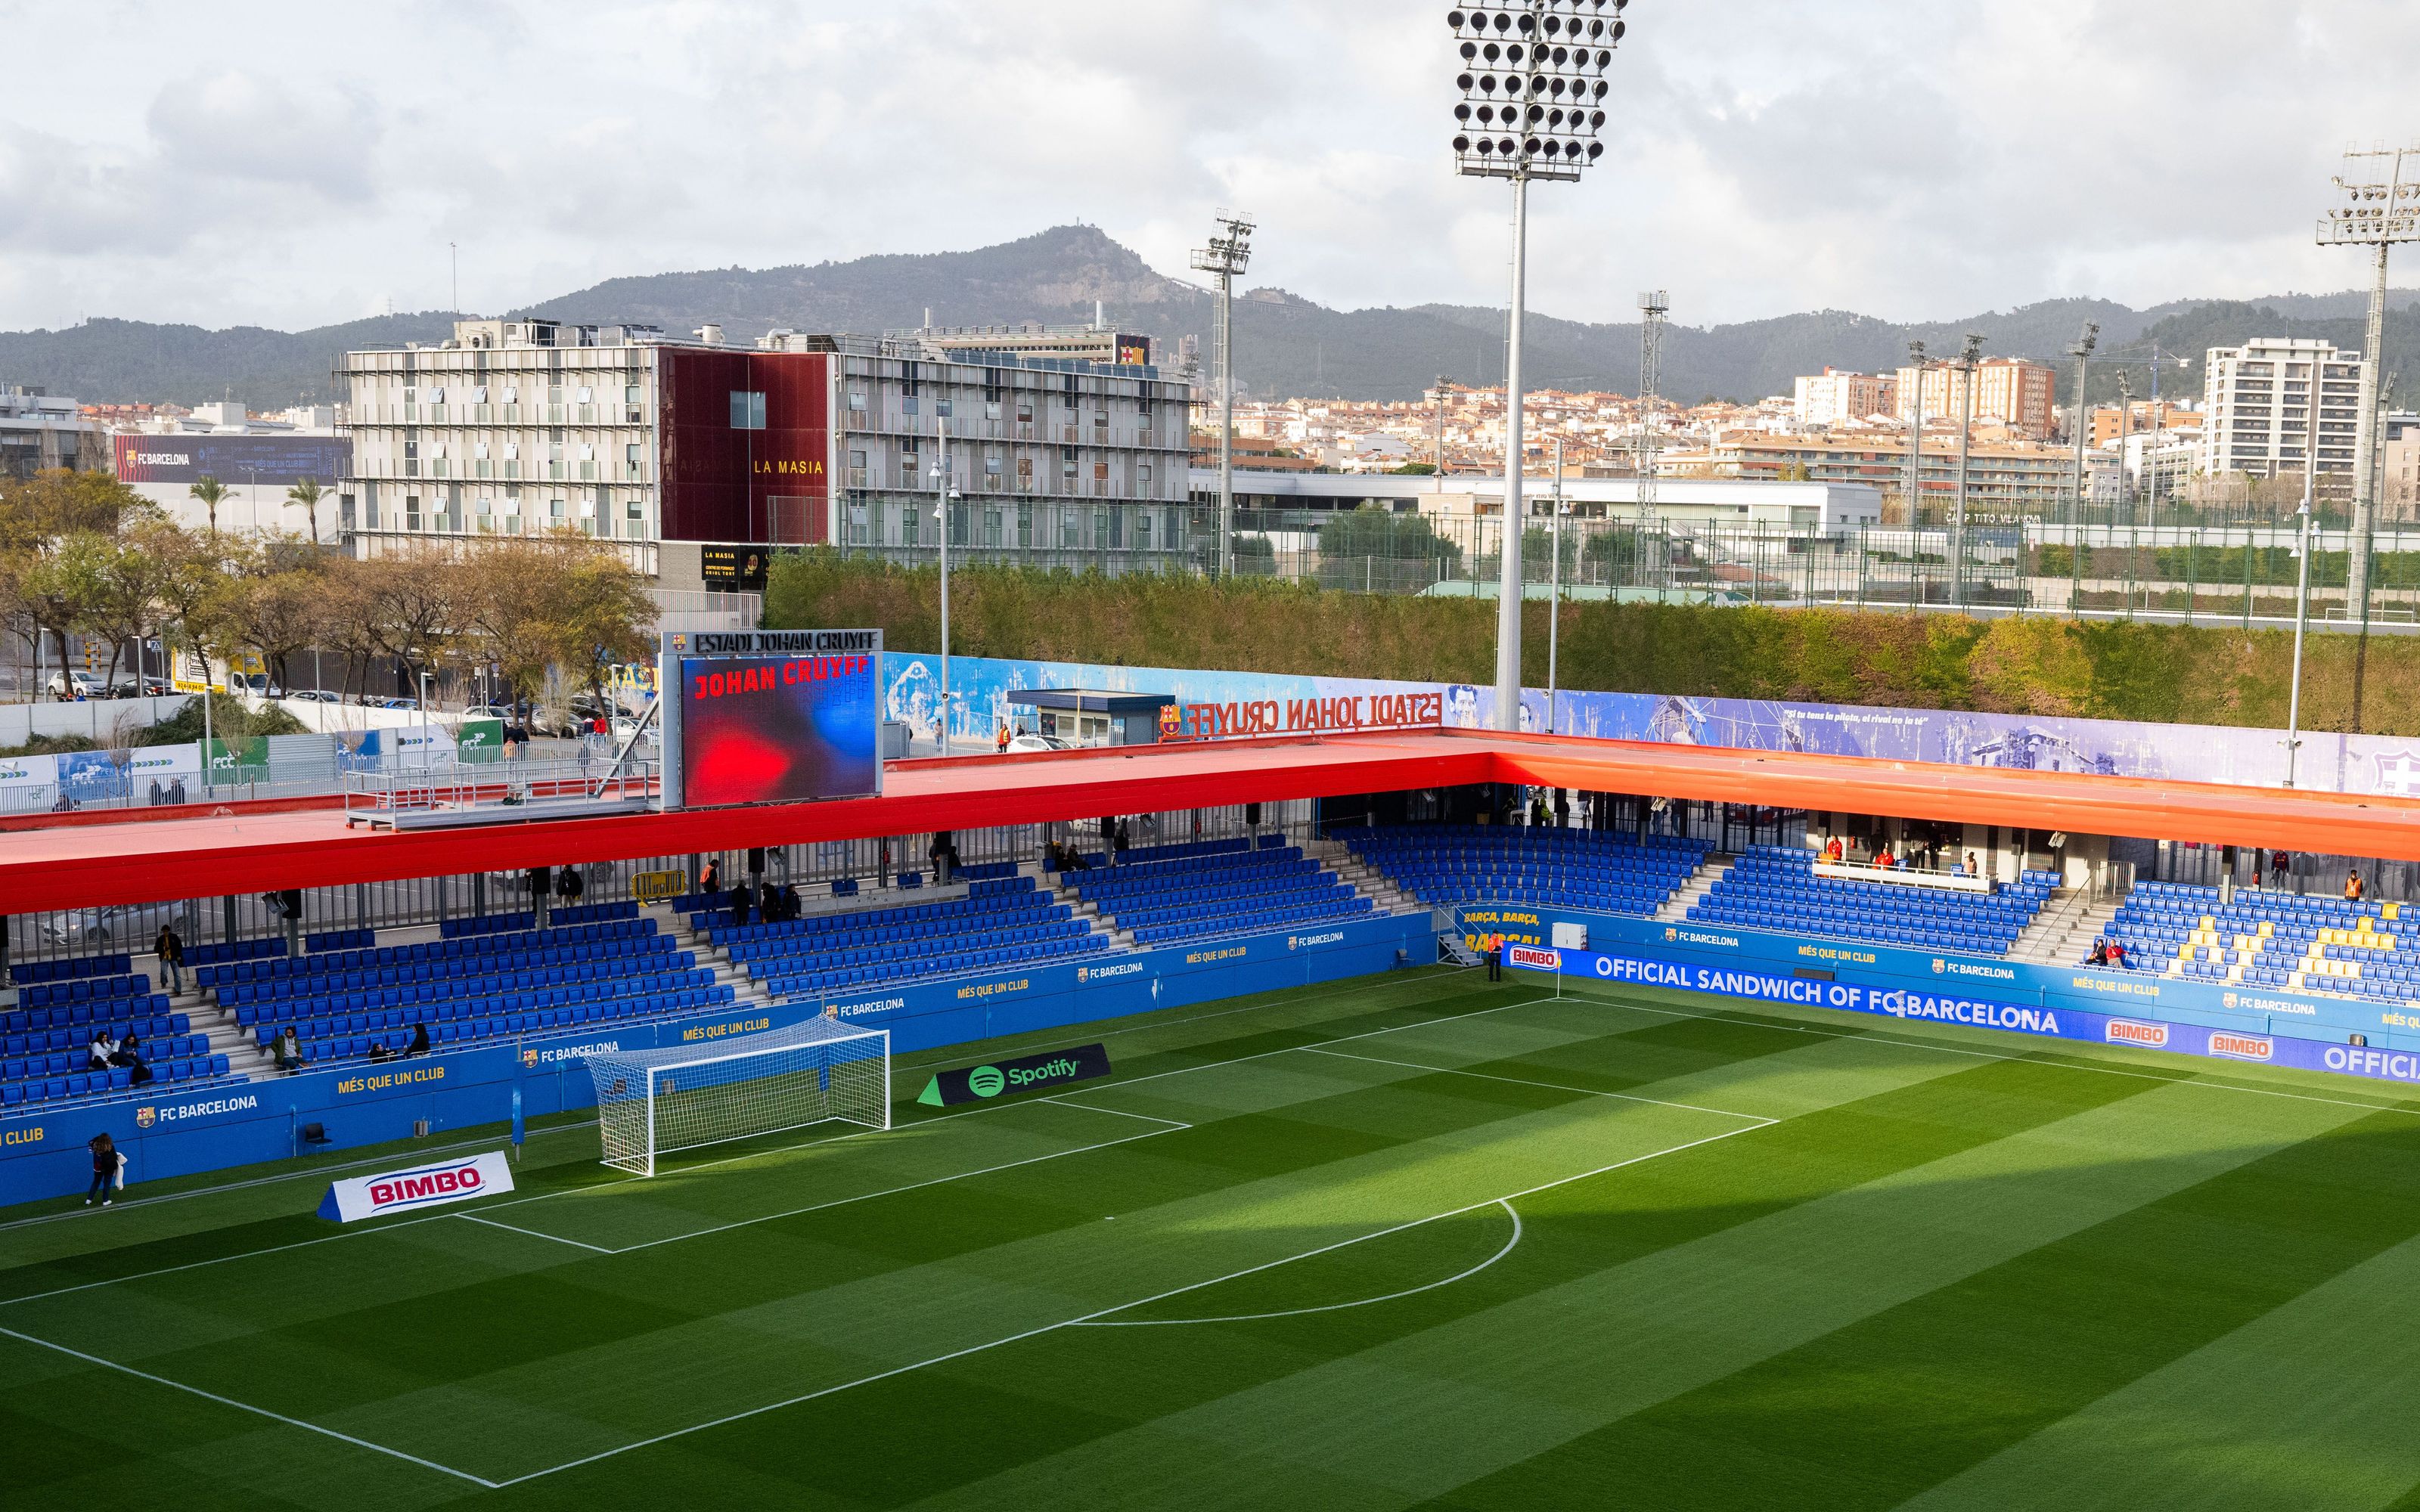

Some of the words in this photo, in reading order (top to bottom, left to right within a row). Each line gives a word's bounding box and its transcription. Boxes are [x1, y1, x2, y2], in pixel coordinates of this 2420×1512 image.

[138, 454, 147, 464] FC
[147, 454, 190, 465] BARCELONA
[266, 460, 278, 468] QUE
[755, 460, 771, 473] LA
[778, 460, 823, 474] MASIA
[1947, 513, 1970, 522] CAP
[1975, 514, 1996, 523] TITO
[696, 634, 754, 653] ESTADI
[755, 632, 813, 652] JOHAN
[817, 631, 878, 651] CRUYFF
[695, 667, 775, 700] JOHAN
[783, 655, 868, 686] CRUYFF
[1797, 710, 1806, 718] tu
[1807, 711, 1825, 720] tens
[1825, 711, 1835, 720] la
[1834, 713, 1860, 723] pilota,
[1862, 714, 1871, 723] el
[1871, 715, 1891, 723] rival
[1904, 717, 1914, 725] la
[213, 757, 235, 769] FCC
[1464, 912, 1500, 924] BARÇA,
[1503, 912, 1540, 926] BARÇA,
[1299, 937, 1307, 947] FC
[1307, 931, 1344, 946] BARCELONA
[1679, 931, 1689, 941] FC
[1690, 933, 1739, 947] BARCELONA
[1187, 951, 1202, 964] MÉS
[1203, 950, 1217, 962] QUE
[1218, 949, 1228, 959] UN
[1229, 947, 1246, 957] CLUB
[1513, 949, 1555, 965] BIMBO
[1798, 945, 1817, 957] MÉS
[1819, 948, 1836, 959] QUE
[1838, 950, 1851, 960] UN
[1853, 952, 1876, 963] CLUB
[1090, 968, 1100, 979] FC
[1100, 962, 1143, 978] BARCELONA
[1947, 963, 1959, 973] FC
[1959, 964, 2015, 980] BARCELONA
[957, 985, 975, 999] MÉS
[976, 984, 993, 997] QUE
[995, 983, 1007, 993] UN
[1008, 979, 1028, 991] CLUB
[1596, 956, 1691, 987] OFFICIAL
[1697, 970, 1821, 1003] SANDWICH
[1829, 986, 1861, 1007] OF
[1869, 990, 1898, 1013] FC
[1907, 995, 2059, 1033] BARCELONA
[2073, 976, 2094, 989] MÉS
[2096, 981, 2116, 992] QUE
[2118, 983, 2132, 993] UN
[2134, 984, 2160, 996] CLUB
[840, 1006, 852, 1017] FC
[852, 998, 904, 1015] BARCELONA
[2240, 997, 2253, 1008] FC
[2254, 999, 2316, 1015] BARCELONA
[2382, 1012, 2406, 1026] MÉS
[683, 1026, 704, 1041] MÉS
[707, 1024, 726, 1039] QUE
[728, 1022, 743, 1034] UN
[745, 1018, 769, 1031] CLUB
[2111, 1023, 2164, 1043] BIMBO
[541, 1050, 554, 1063] FC
[556, 1041, 619, 1061] BARCELONA
[2214, 1036, 2270, 1056] BIMBO
[338, 1077, 365, 1094] MÉS
[367, 1074, 391, 1091] QUE
[395, 1072, 412, 1085] UN
[414, 1067, 445, 1082] CLUB
[1009, 1059, 1077, 1086] Spotify
[160, 1108, 176, 1122] FC
[178, 1095, 258, 1119] BARCELONA
[6, 1127, 44, 1145] CLUB
[371, 1168, 480, 1205] BIMBO
